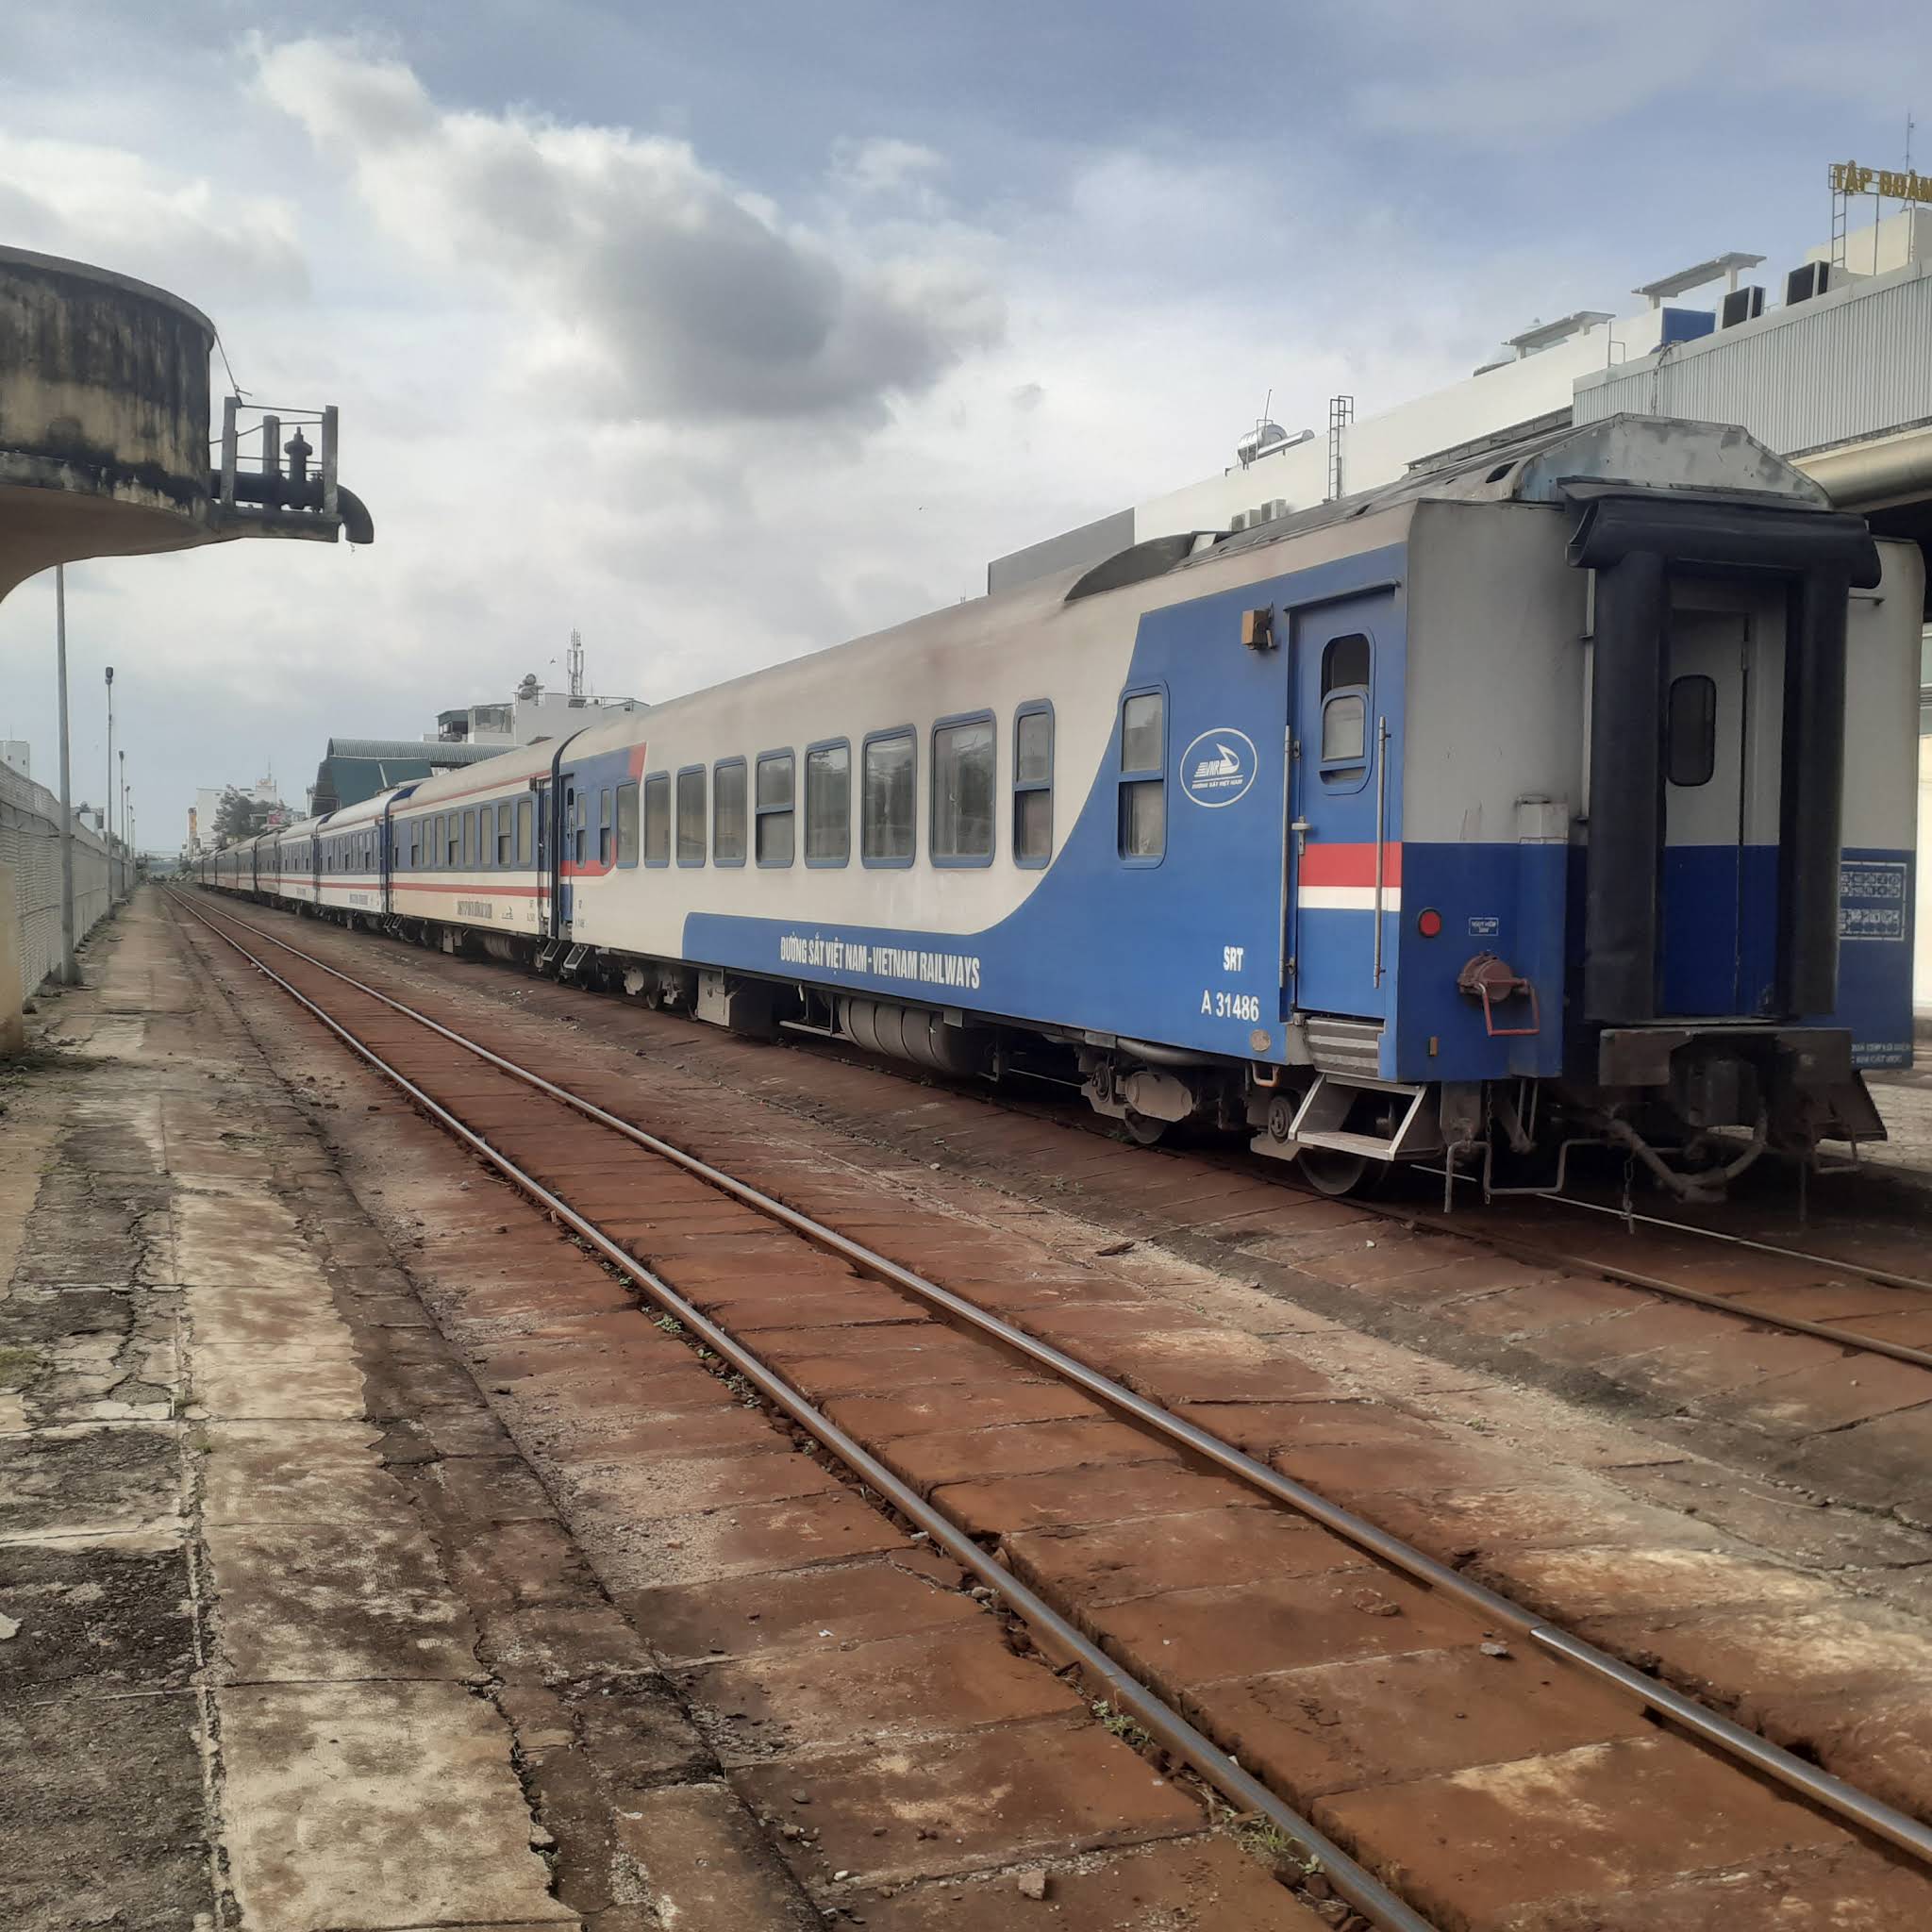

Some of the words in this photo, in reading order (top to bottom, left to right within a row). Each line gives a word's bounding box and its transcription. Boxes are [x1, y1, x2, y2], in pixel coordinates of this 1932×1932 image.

[780, 931, 808, 964] ĐƯỜNG
[808, 931, 824, 967] SẮT
[825, 937, 844, 975] VIỆT
[845, 942, 867, 973] NAM
[873, 946, 918, 980] VIETNAM
[919, 952, 980, 990] RAILWAYS
[1223, 945, 1244, 972] SRT
[1201, 990, 1212, 1015] A
[1216, 991, 1259, 1022] 31486
